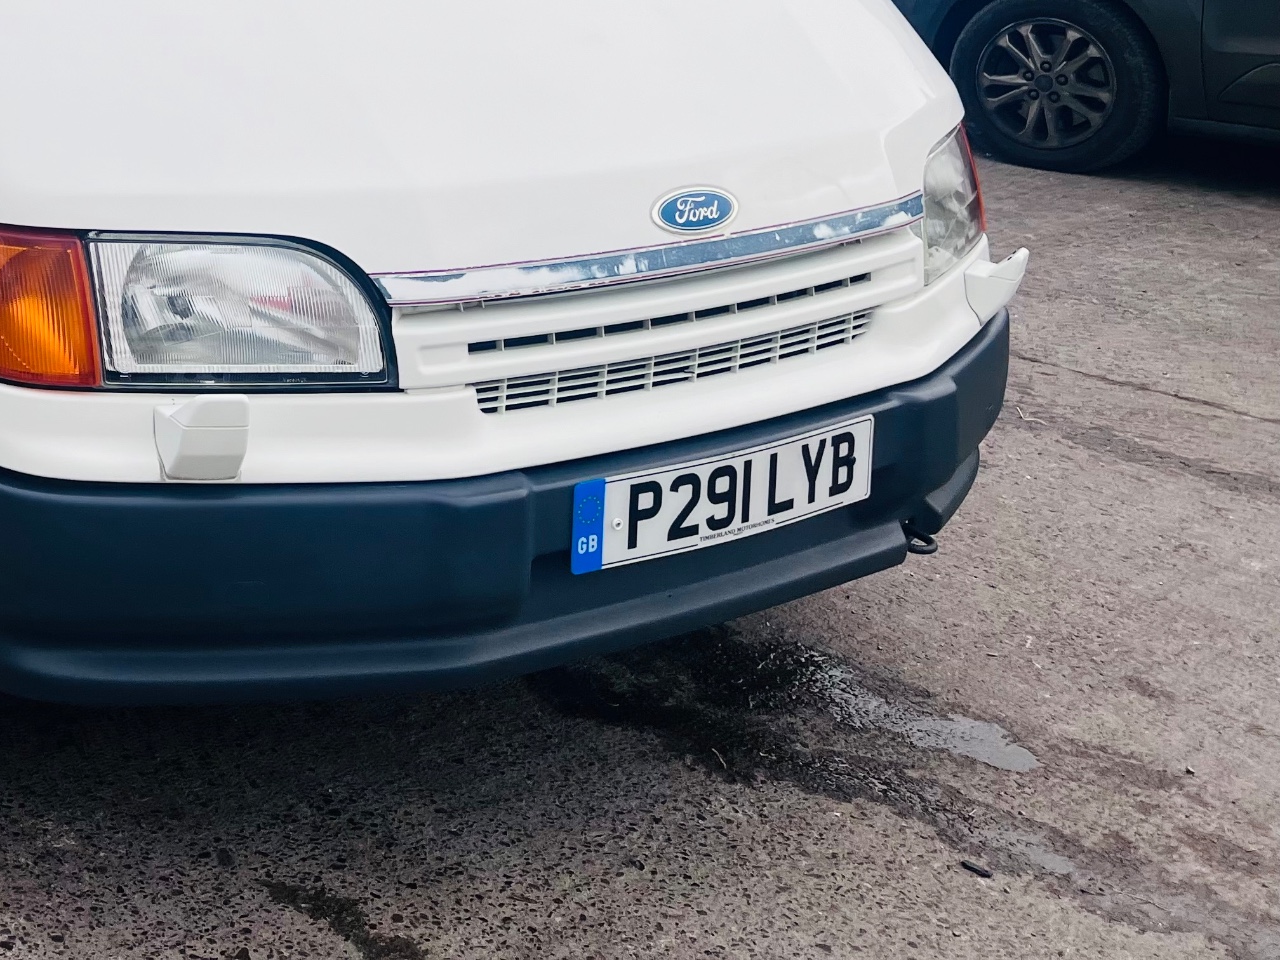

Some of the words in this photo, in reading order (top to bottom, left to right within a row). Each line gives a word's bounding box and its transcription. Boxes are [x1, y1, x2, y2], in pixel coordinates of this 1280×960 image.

[675, 195, 720, 224] Ford
[626, 459, 753, 550] P291
[767, 431, 857, 517] LYB
[699, 528, 736, 542] TIMBERLAND
[736, 518, 775, 533] MOTORHOMES
[577, 533, 599, 555] GB
